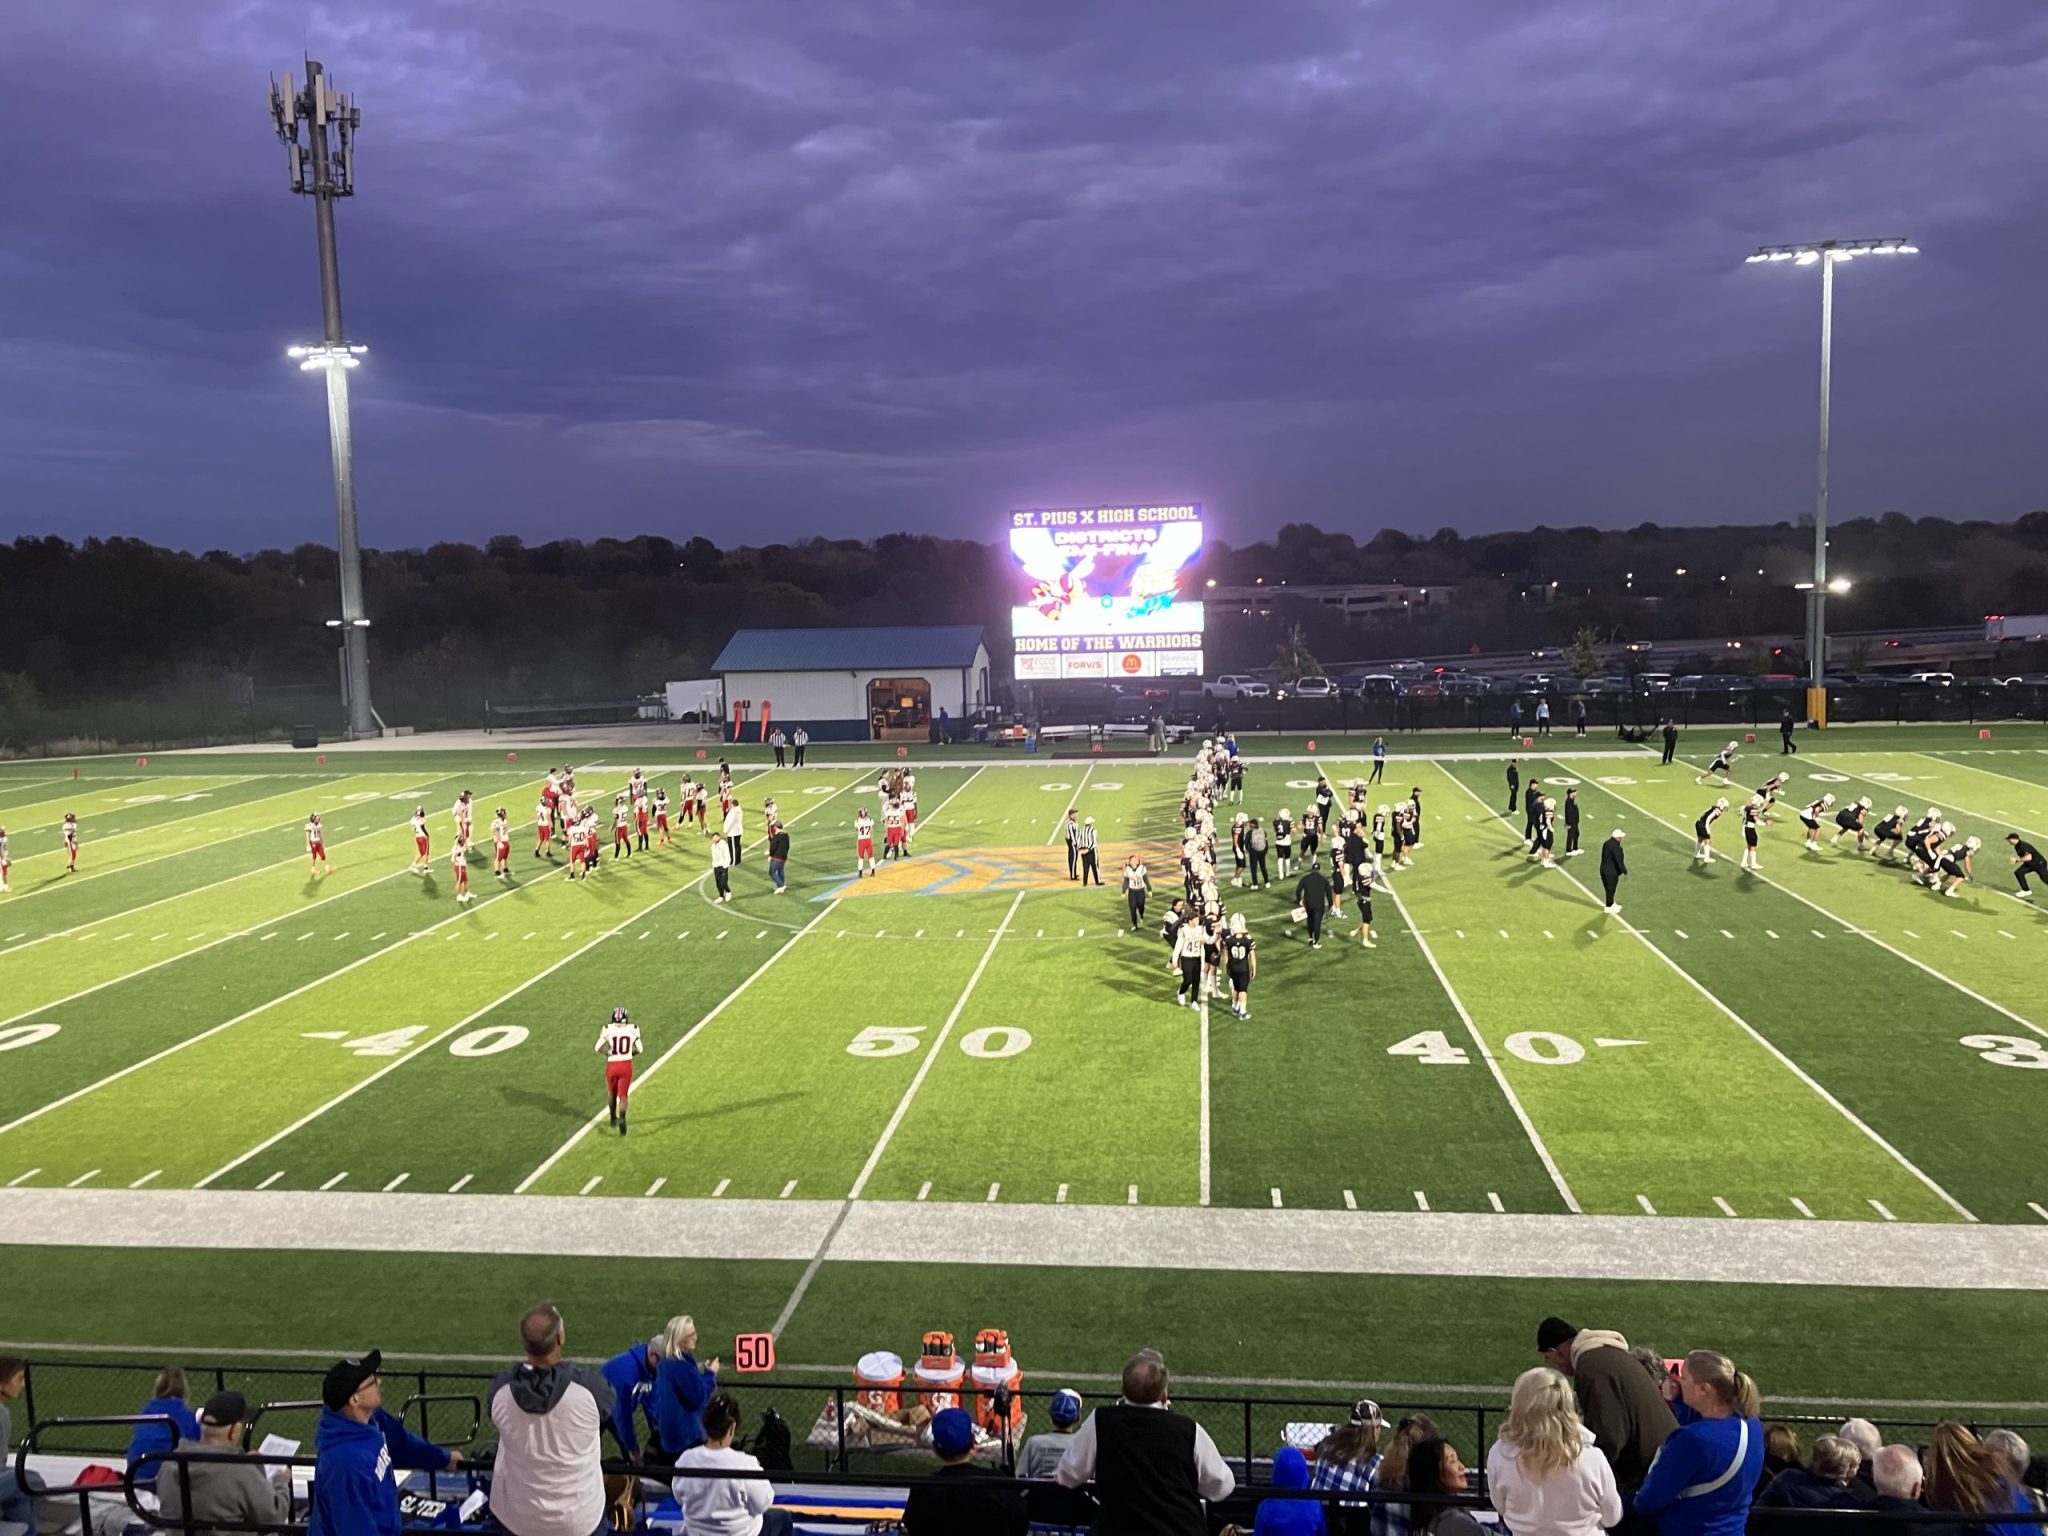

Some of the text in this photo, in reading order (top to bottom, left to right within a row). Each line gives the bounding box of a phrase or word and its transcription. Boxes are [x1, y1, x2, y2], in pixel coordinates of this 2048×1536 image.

[1014, 506, 1198, 526] ST. PIUS X HIGH SCHOOL
[1015, 634, 1202, 651] HOME OF THE WARRIORS
[341, 1025, 529, 1057] 40
[612, 1035, 630, 1055] 10
[846, 1026, 1032, 1058] 50
[1387, 1030, 1586, 1065] 40
[738, 1336, 769, 1369] 50
